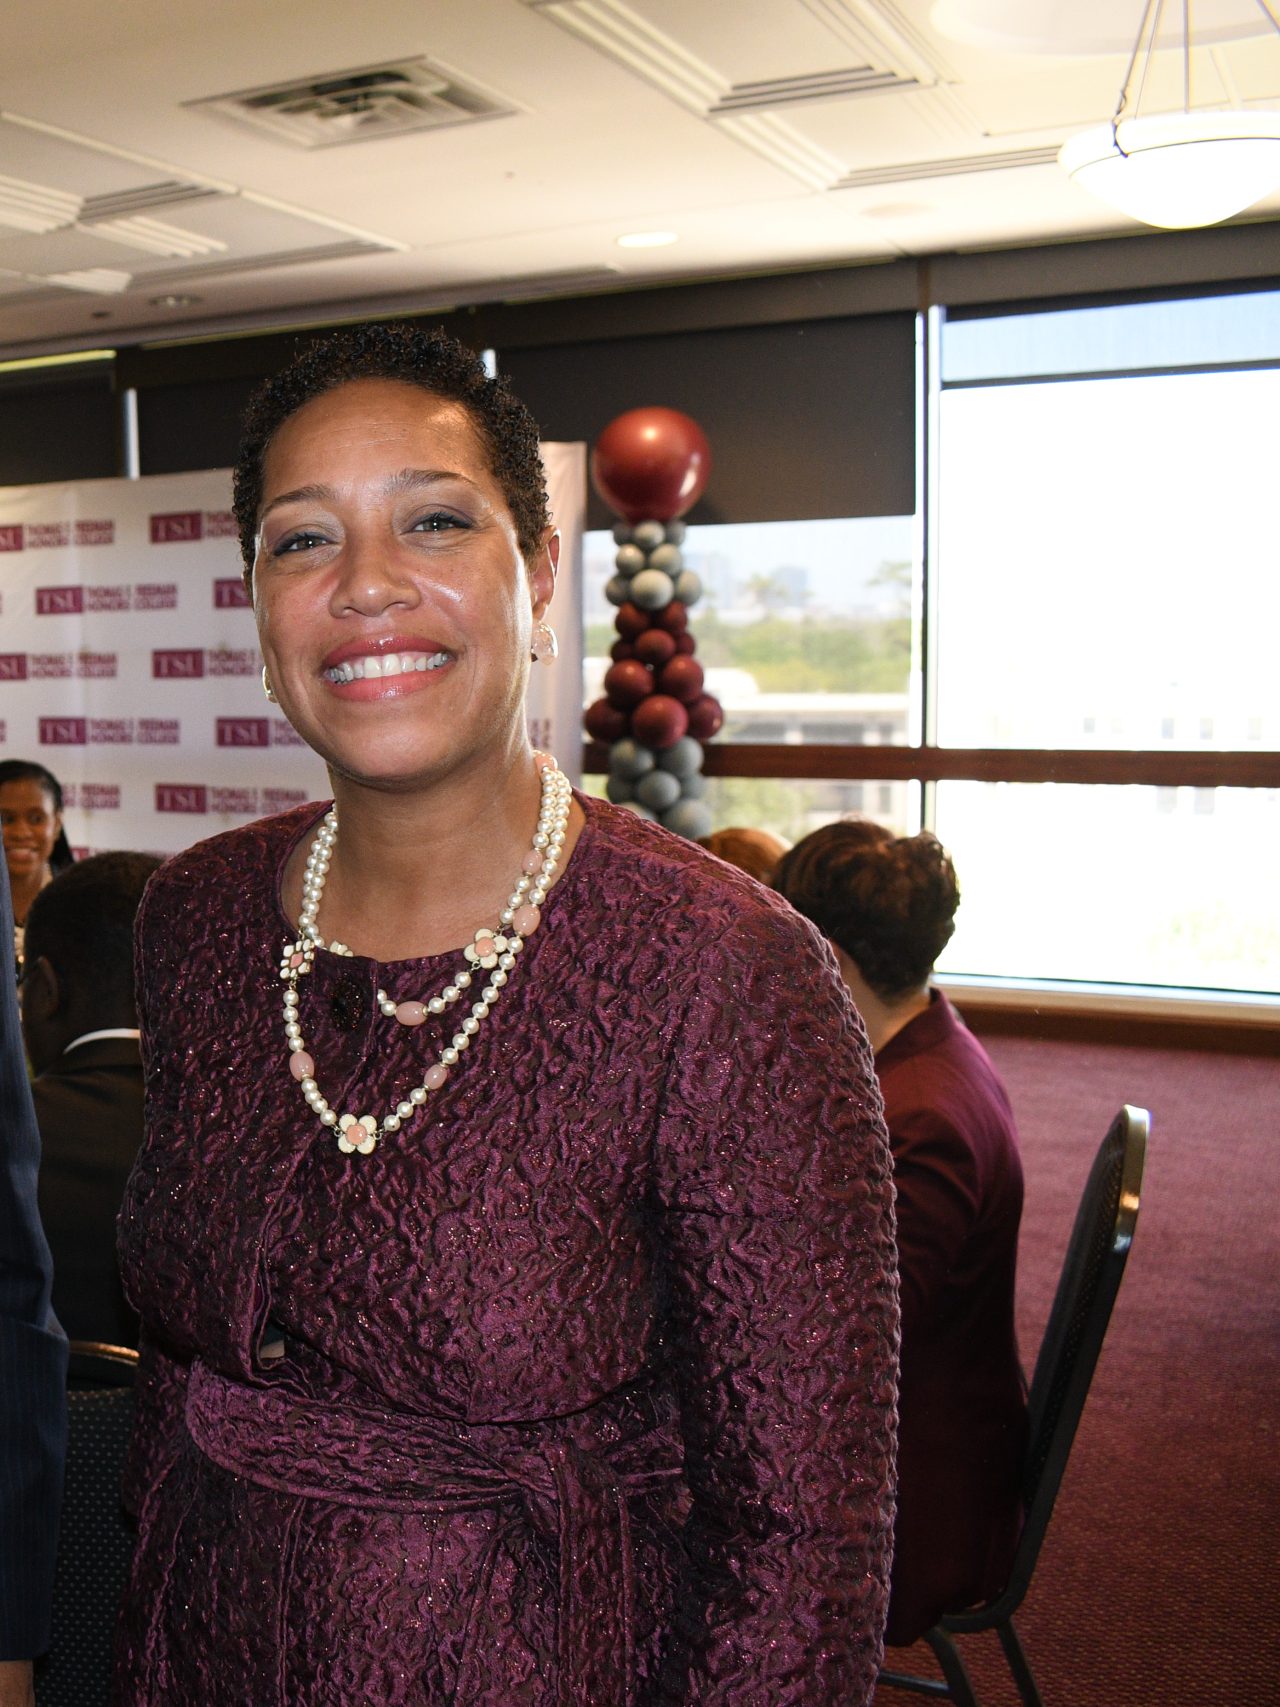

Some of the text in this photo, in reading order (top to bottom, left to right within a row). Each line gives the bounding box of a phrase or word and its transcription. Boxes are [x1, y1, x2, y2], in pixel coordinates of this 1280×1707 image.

[157, 516, 197, 540] TSU
[41, 590, 78, 612] TSU
[159, 653, 199, 675] TSU
[45, 721, 82, 742] TSU
[223, 722, 264, 744] TSU
[162, 789, 201, 810] TSU
